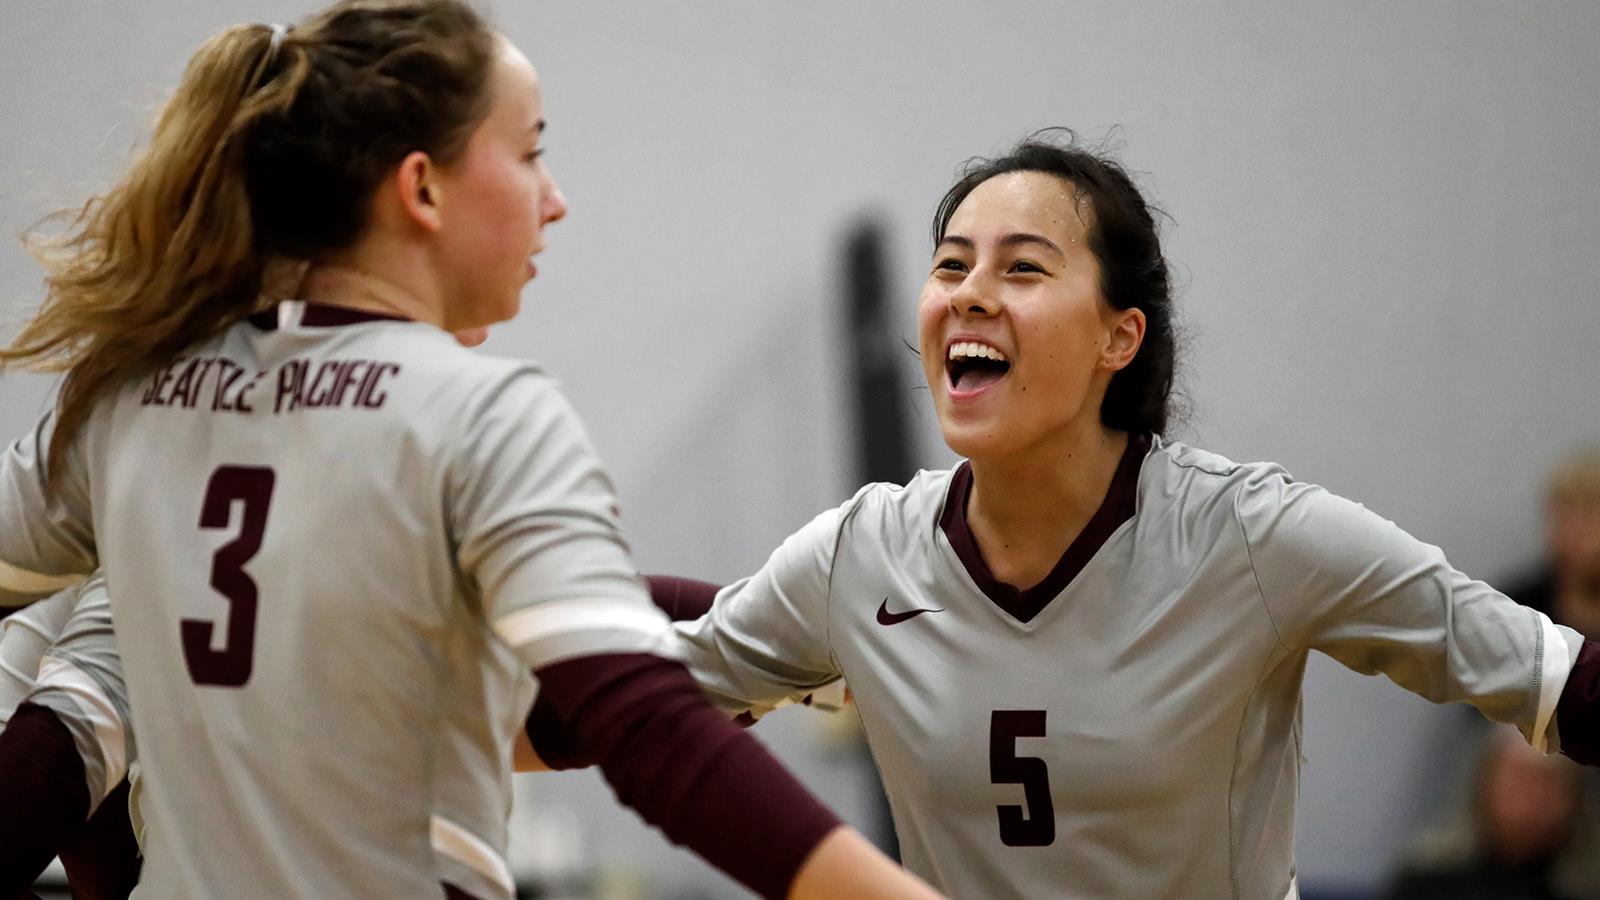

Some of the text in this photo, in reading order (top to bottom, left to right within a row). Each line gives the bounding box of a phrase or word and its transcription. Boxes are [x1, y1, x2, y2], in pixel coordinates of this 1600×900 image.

[273, 358, 401, 413] PACIFIC
[180, 464, 276, 688] 3
[990, 710, 1055, 847] 5
